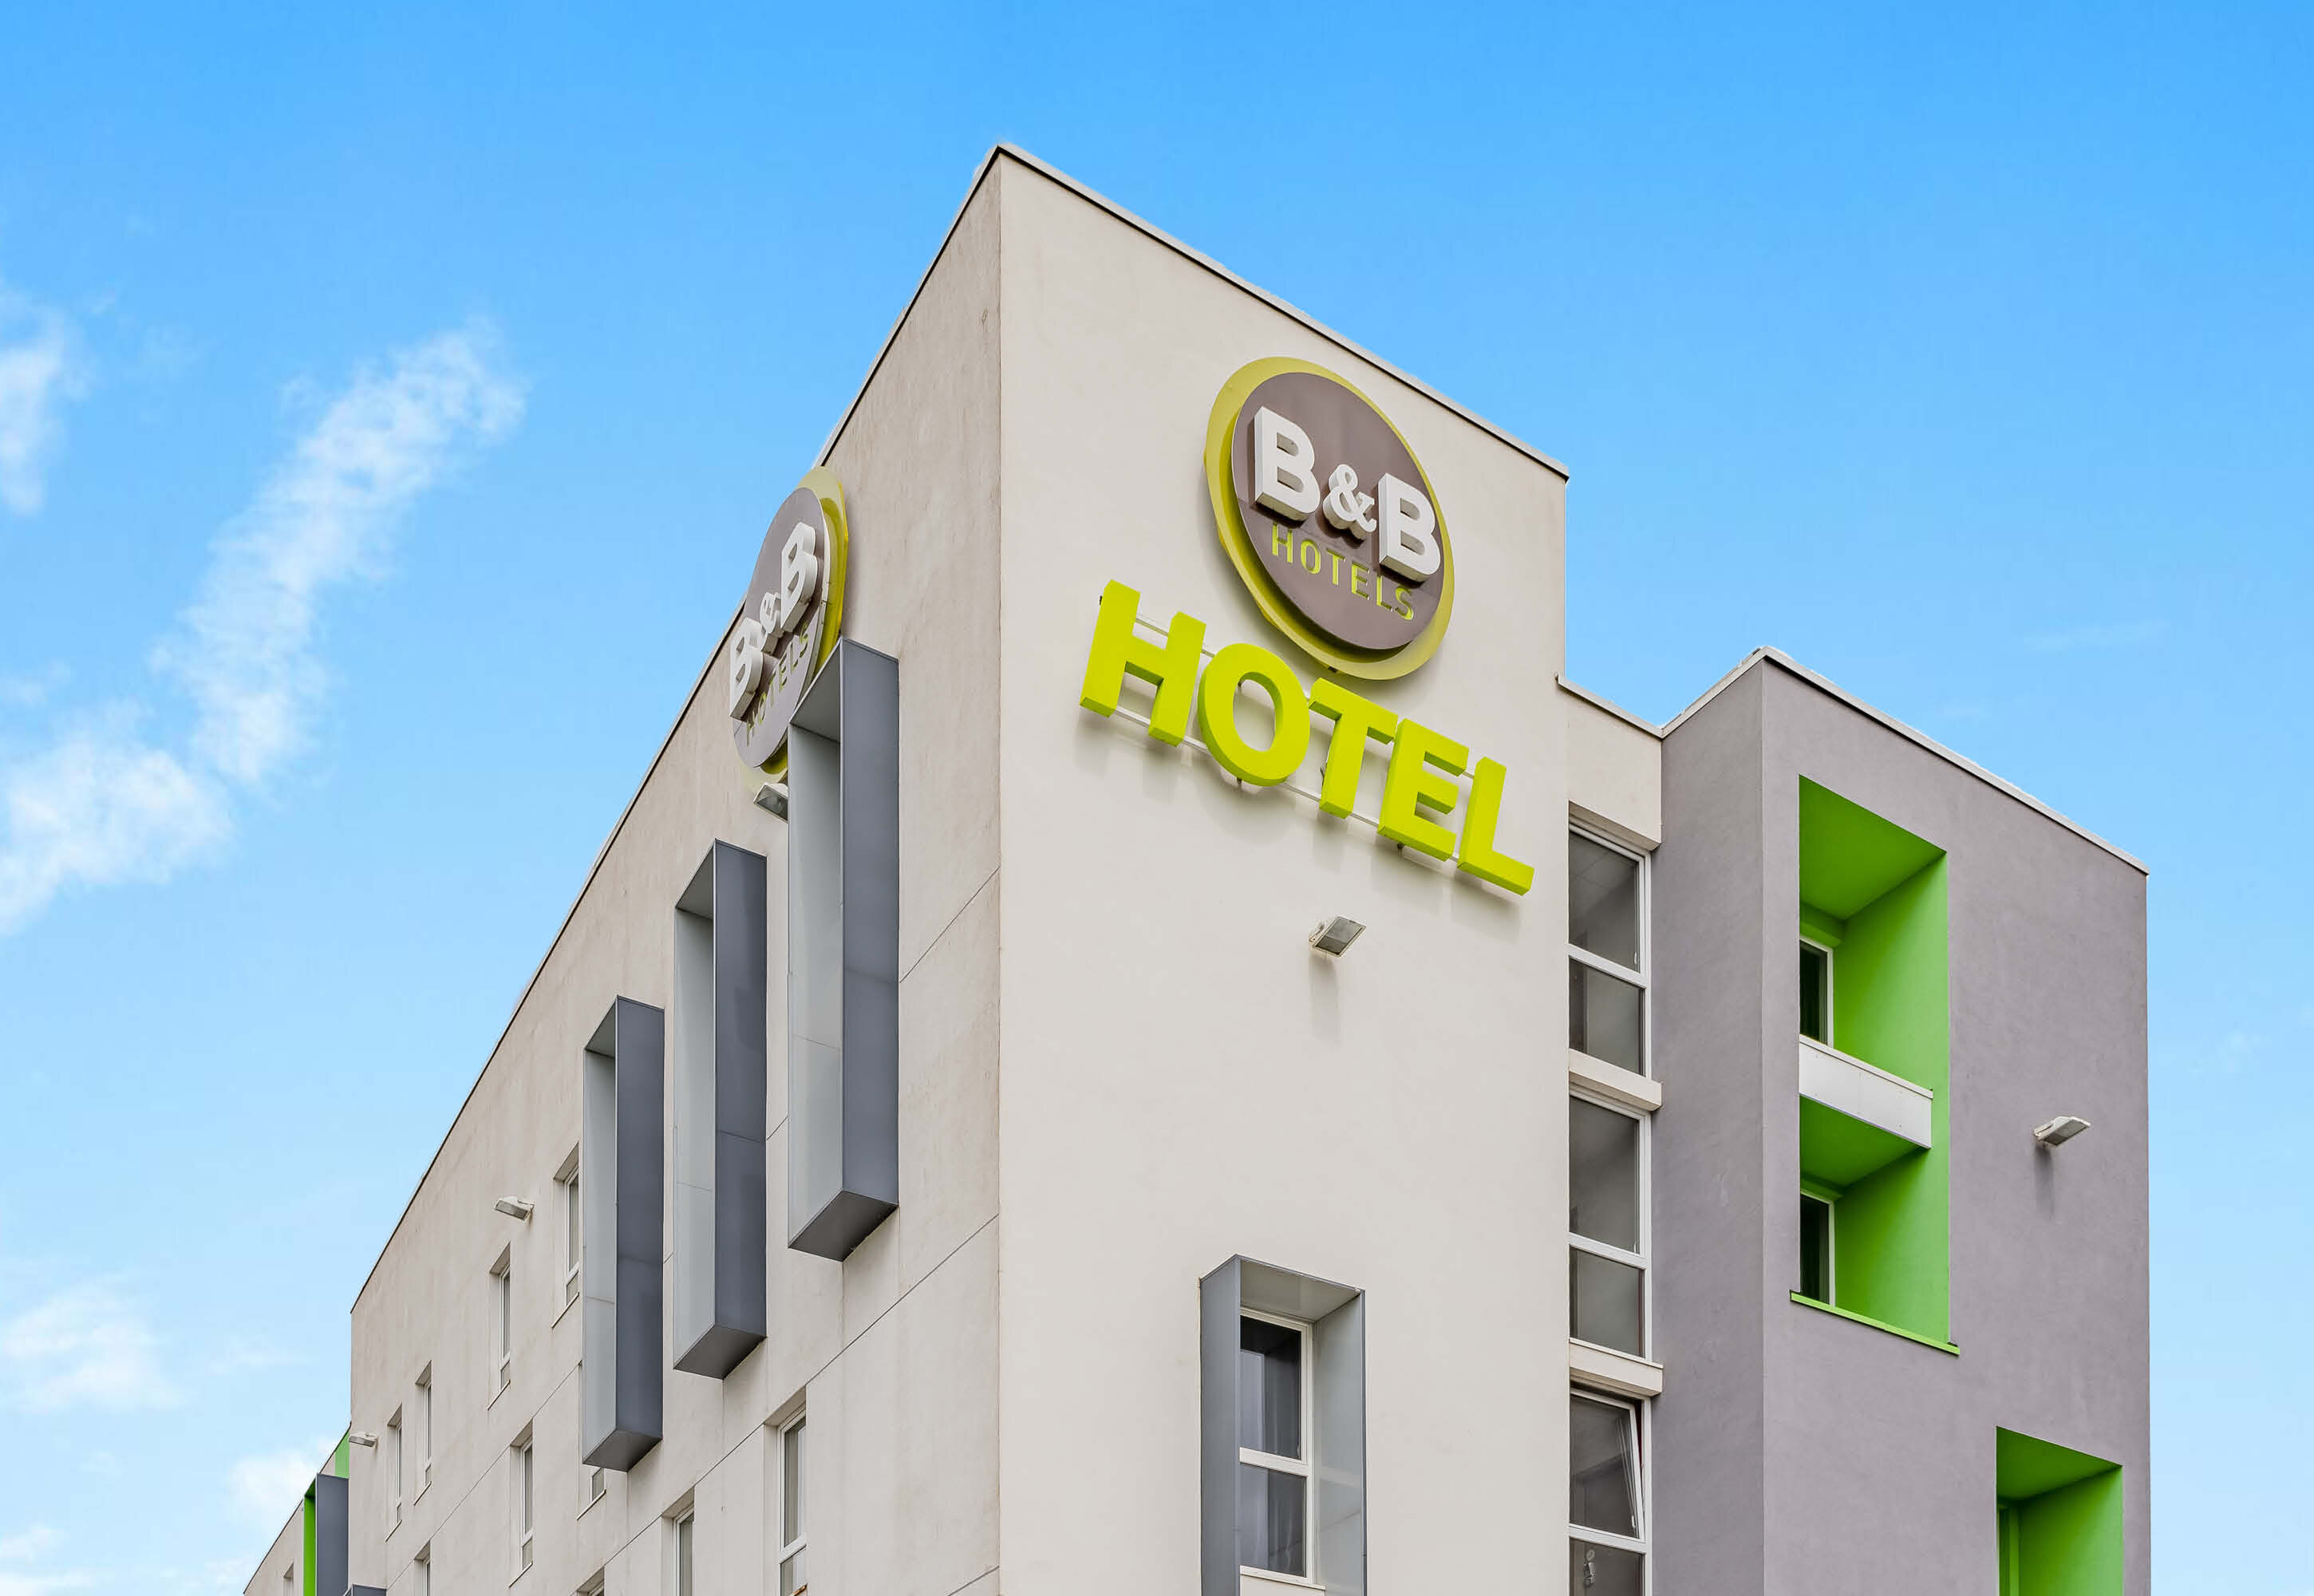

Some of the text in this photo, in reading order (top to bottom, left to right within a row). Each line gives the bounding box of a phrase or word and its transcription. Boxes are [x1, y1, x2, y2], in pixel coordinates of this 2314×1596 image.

[1253, 406, 1440, 582] B&B
[1271, 523, 1415, 622] HOTELS
[1080, 579, 1534, 895] HOTEL
